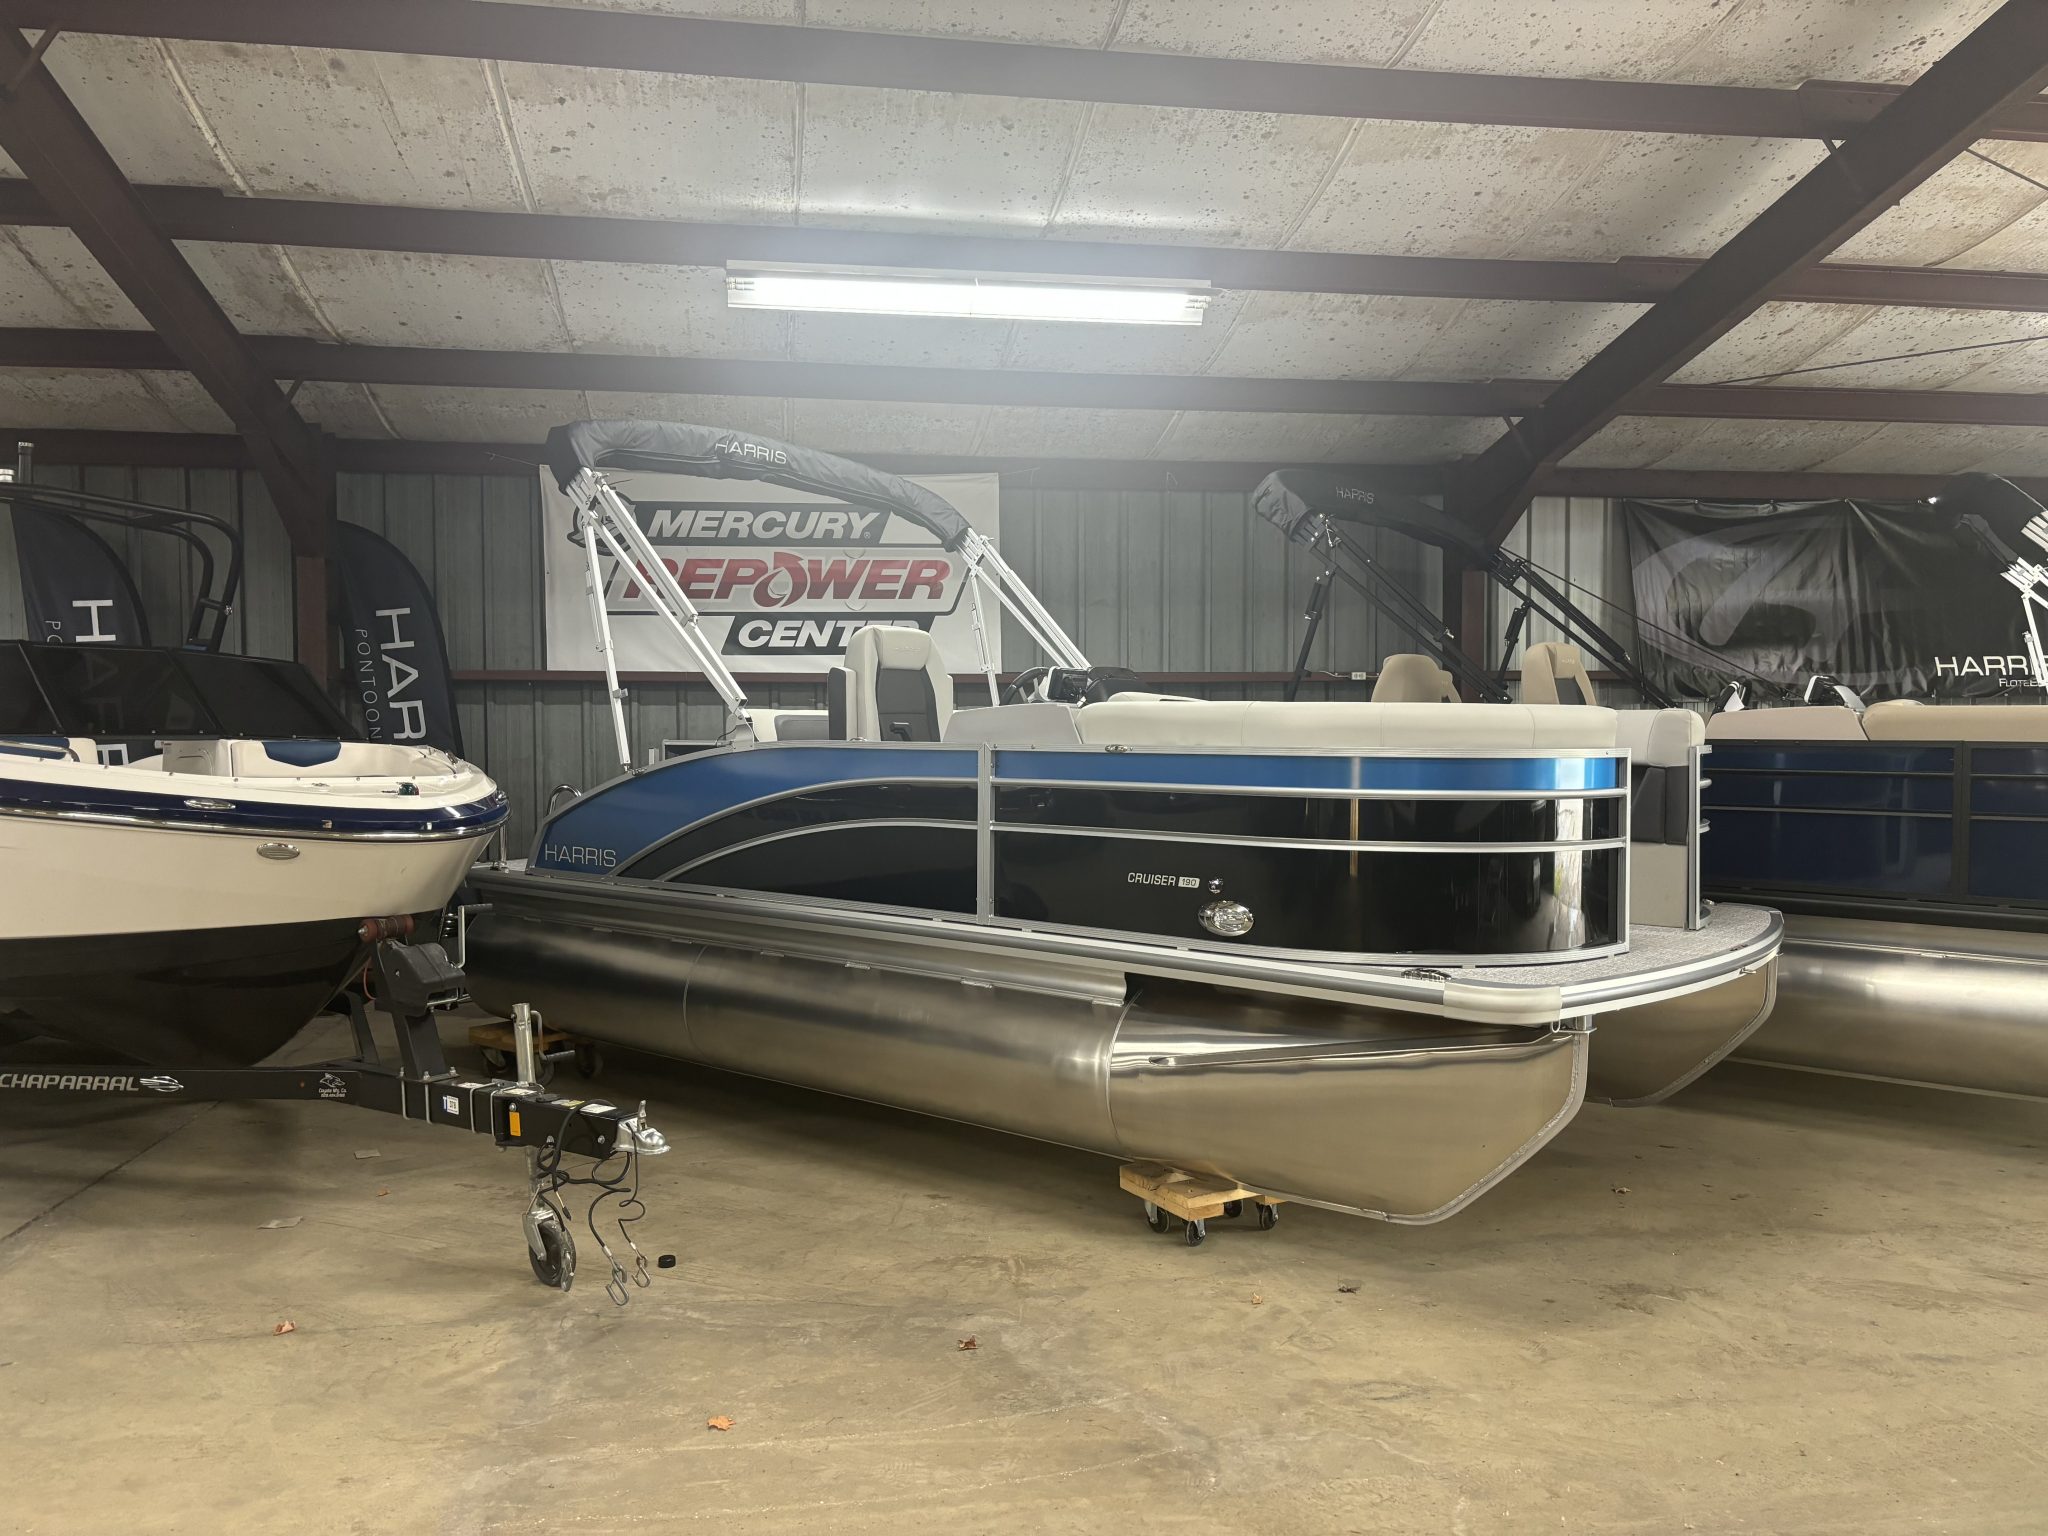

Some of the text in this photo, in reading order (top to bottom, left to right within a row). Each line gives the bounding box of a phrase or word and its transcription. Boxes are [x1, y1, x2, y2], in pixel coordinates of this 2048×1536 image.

[715, 440, 787, 465] HARRIS
[647, 510, 880, 540] MERCURY
[738, 619, 919, 648] CENT
[544, 843, 616, 868] HARRIS
[1127, 872, 1197, 887] CRUISER 190
[0, 1073, 139, 1092] CHAPARRAL
